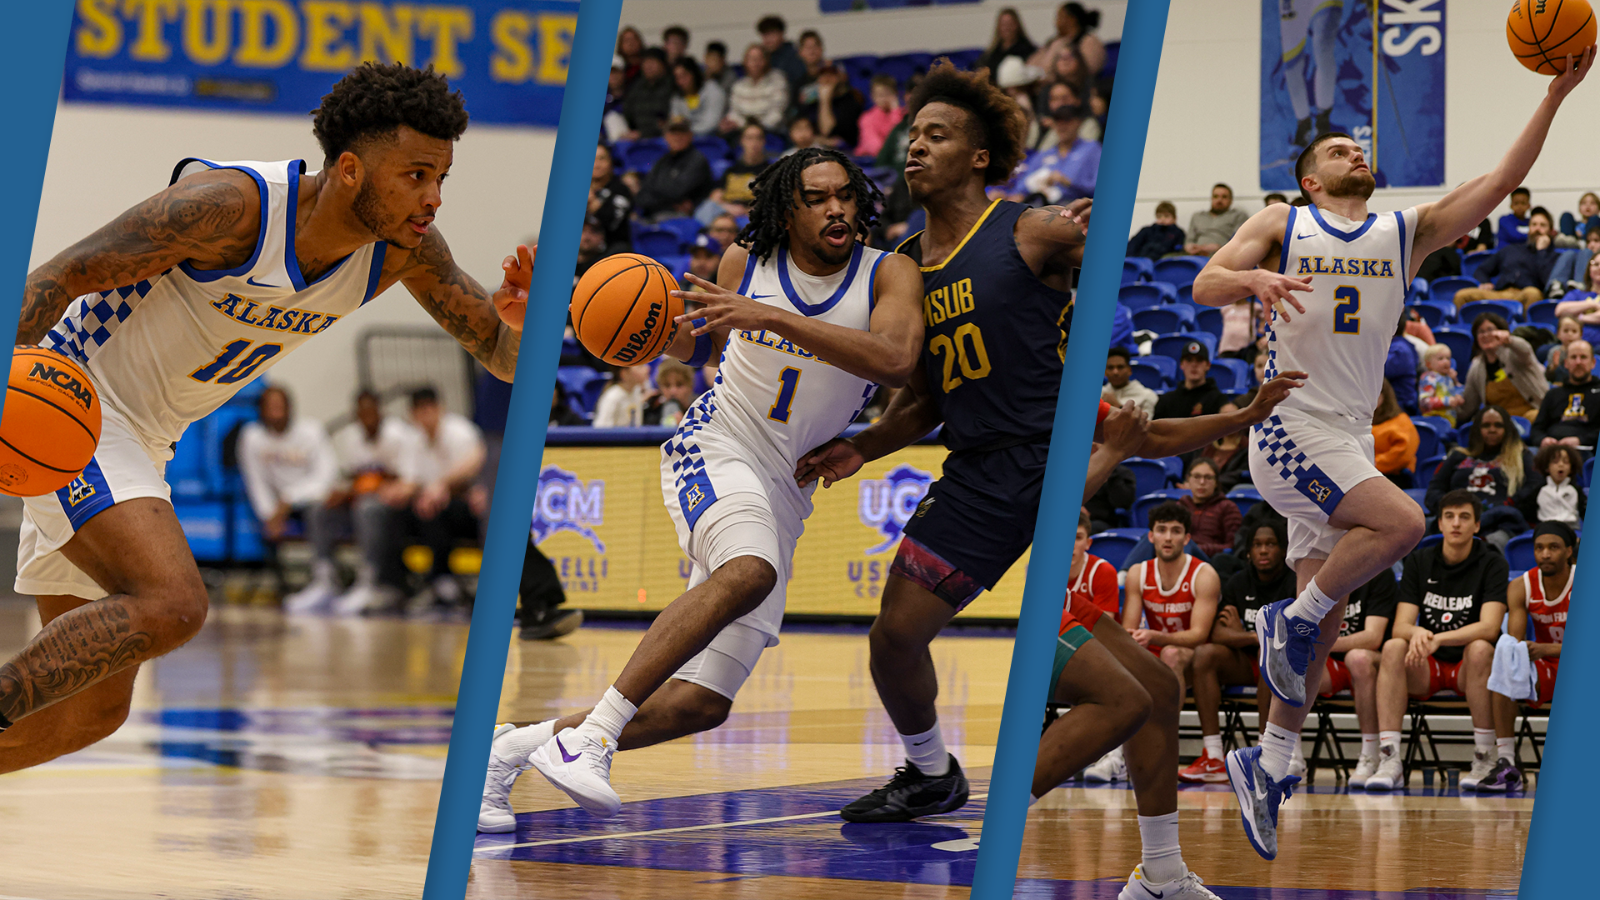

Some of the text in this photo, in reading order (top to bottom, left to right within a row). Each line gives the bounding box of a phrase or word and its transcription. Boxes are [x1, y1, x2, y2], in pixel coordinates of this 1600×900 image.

[75, 0, 473, 79] STUDENT
[1296, 255, 1395, 279] ALASKA
[208, 292, 342, 336] ALASKA
[612, 302, 662, 363] Wilson
[1333, 284, 1361, 336] 2
[187, 337, 283, 386] 10
[929, 322, 992, 394] 20
[28, 361, 93, 410] NCAA
[57, 387, 75, 402] GAME
[766, 365, 802, 425] 1
[532, 480, 605, 526] CM
[858, 479, 930, 528] UC
[548, 556, 608, 579] ELLI
